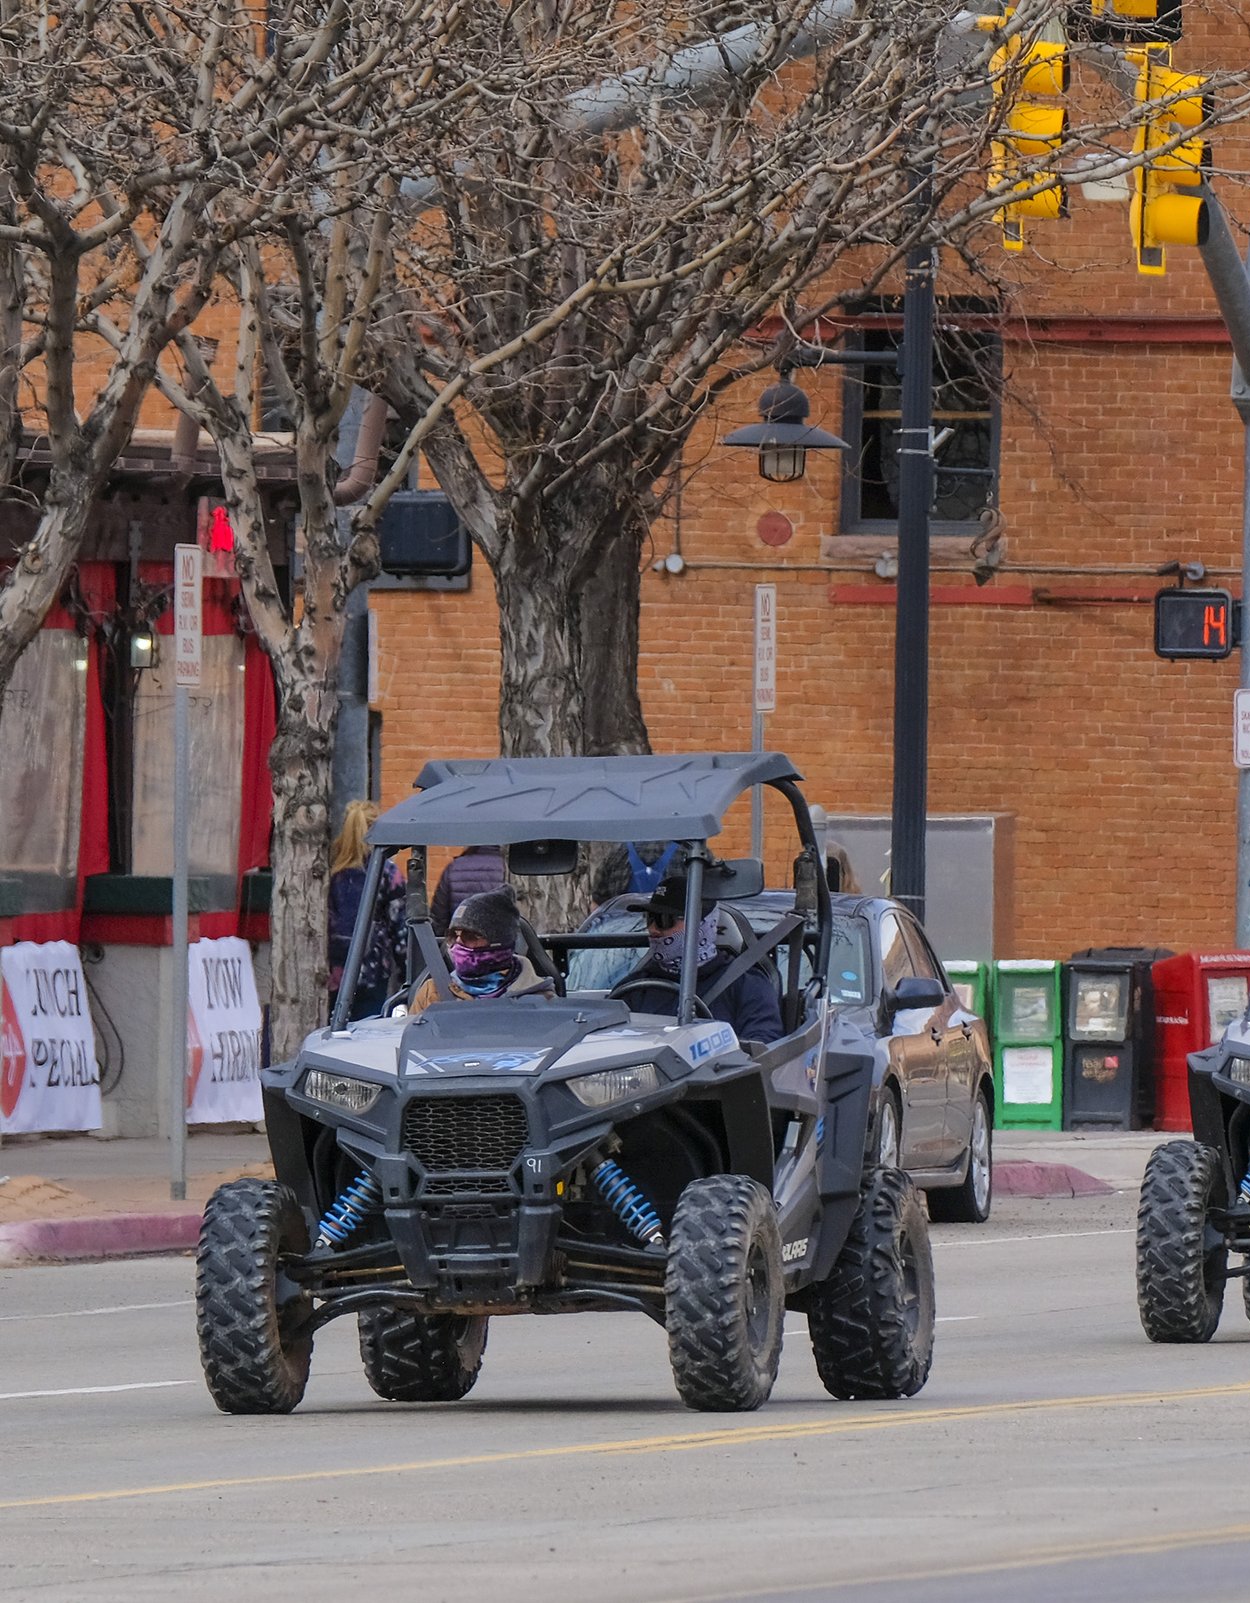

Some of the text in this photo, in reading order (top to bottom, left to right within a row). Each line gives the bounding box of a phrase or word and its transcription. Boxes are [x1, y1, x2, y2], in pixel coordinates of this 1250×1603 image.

[182, 555, 194, 580] NO
[761, 593, 771, 616] NO
[1203, 605, 1226, 647] 14
[201, 957, 243, 1009] NOW
[526, 1158, 542, 1173] 91
